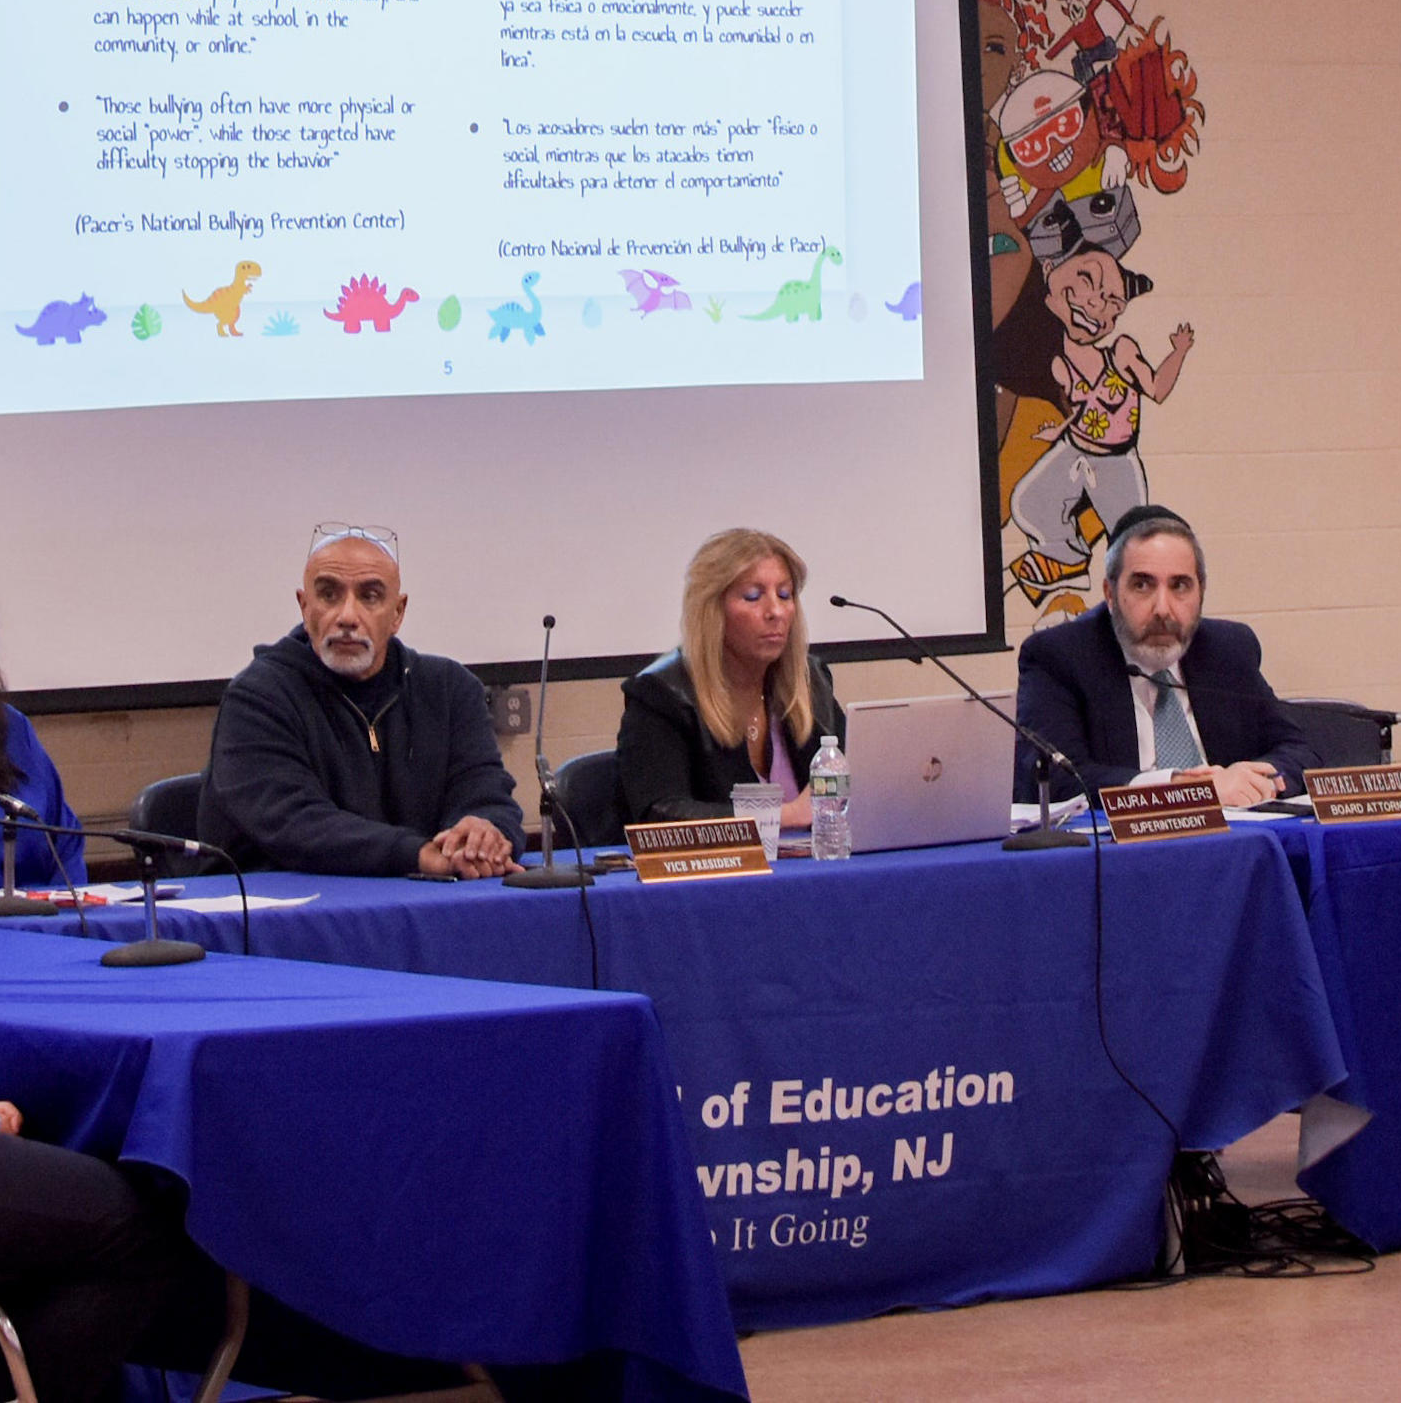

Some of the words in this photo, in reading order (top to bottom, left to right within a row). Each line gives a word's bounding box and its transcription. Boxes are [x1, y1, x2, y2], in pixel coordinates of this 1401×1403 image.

[93, 10, 120, 26] can
[126, 6, 180, 36] happen
[186, 5, 220, 26] while
[227, 11, 243, 27] at
[252, 7, 299, 28] school,
[305, 10, 319, 27] in
[326, 9, 349, 28] the
[499, 0, 515, 22] ya
[520, 0, 543, 13] sea
[587, 1, 597, 14] o
[702, 3, 711, 25] y
[757, 0, 804, 17] suceder
[500, 24, 556, 41] mientras
[561, 25, 590, 42] está
[595, 28, 611, 42] en
[616, 23, 626, 42] la
[683, 30, 698, 43] en
[703, 25, 714, 44] la
[719, 25, 782, 44] comunidad
[786, 31, 795, 44] o
[799, 31, 815, 44] en
[94, 36, 179, 63] community,
[185, 40, 201, 54] or
[96, 95, 142, 114] "Those
[149, 94, 203, 124] bullying
[210, 91, 253, 114] often
[259, 95, 291, 114] have
[298, 100, 333, 115] more
[340, 94, 395, 124] physical
[401, 101, 416, 115] or
[96, 121, 138, 142] social
[209, 121, 244, 142] while
[252, 123, 291, 142] those
[300, 121, 359, 149] targeted
[365, 124, 396, 142] have
[537, 116, 605, 136] acosadores
[610, 117, 649, 136] suelen
[656, 120, 686, 136] tener
[728, 117, 762, 144] poder
[810, 123, 818, 136] o
[96, 146, 167, 179] difficulty
[174, 152, 239, 179] stopping
[248, 151, 270, 169] the
[277, 151, 340, 169] behavior"
[546, 147, 600, 163] mientras
[605, 151, 627, 169] que
[633, 144, 651, 163] los
[656, 144, 710, 163] atacados
[717, 148, 754, 163] tienen
[503, 168, 575, 189] dificultades
[580, 176, 608, 198] para
[613, 170, 658, 189] detener
[665, 170, 675, 189] el
[681, 170, 783, 197] comportamiento"
[75, 213, 135, 236] (Pacer's
[141, 210, 202, 232] National
[209, 210, 264, 240] Bullying
[271, 211, 347, 231] Prevention
[353, 209, 406, 231] Center)
[498, 238, 546, 258] (Centro
[551, 237, 602, 256] Nacional
[607, 237, 621, 256] de
[626, 238, 691, 256] Prevención
[697, 236, 714, 254] del
[720, 235, 767, 261] Bullying
[771, 234, 784, 253] de
[790, 234, 826, 255] Pacer)
[444, 359, 454, 376] 5
[1312, 773, 1359, 796] MICHAEL
[1107, 792, 1149, 812] LAURA
[1151, 790, 1163, 806] A.
[1164, 786, 1214, 804] WINTERS
[1330, 801, 1365, 817] BOARD
[635, 825, 694, 849] HERIBERTO
[697, 822, 752, 845] RODRIGUEZ
[1129, 814, 1208, 835] SUPERINTENDENT
[663, 859, 689, 873] VICE
[690, 855, 742, 872] PRESIDENT
[701, 1081, 751, 1129] of
[769, 1065, 1015, 1125] Education
[892, 1132, 954, 1182] NJ
[731, 1217, 757, 1252] It
[770, 1208, 870, 1249] Going
